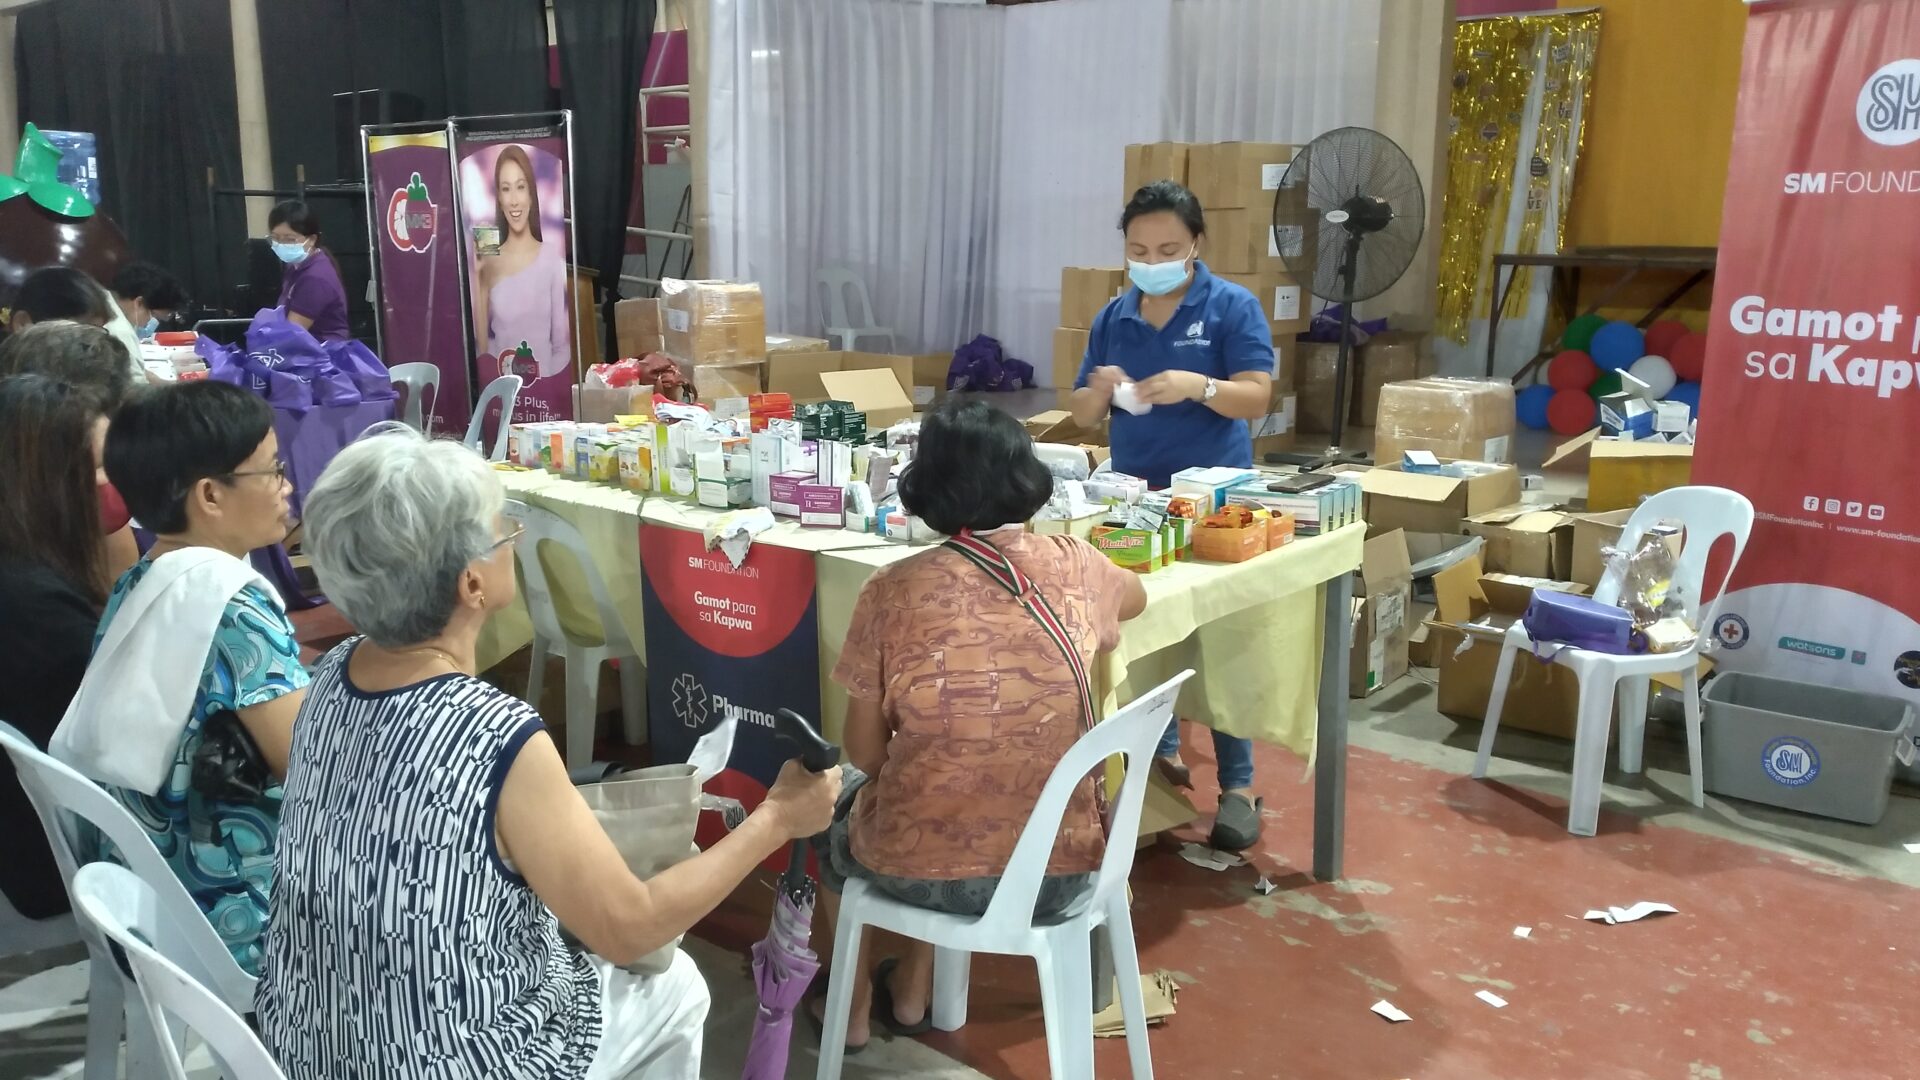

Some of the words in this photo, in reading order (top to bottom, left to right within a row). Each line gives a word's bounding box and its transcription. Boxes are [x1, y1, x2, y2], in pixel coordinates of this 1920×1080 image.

[1784, 172, 1826, 194] SM
[1729, 295, 1903, 342] Gamot
[1744, 350, 1796, 380] sa
[1807, 343, 1920, 398] Kap
[524, 396, 550, 411] Plus,
[688, 556, 703, 569] SM
[694, 590, 731, 610] Gamot
[732, 601, 756, 615] para
[699, 611, 711, 622] sa
[713, 610, 752, 631] Kapwa
[1786, 640, 1837, 656] watsons
[712, 694, 775, 729] Pharma
